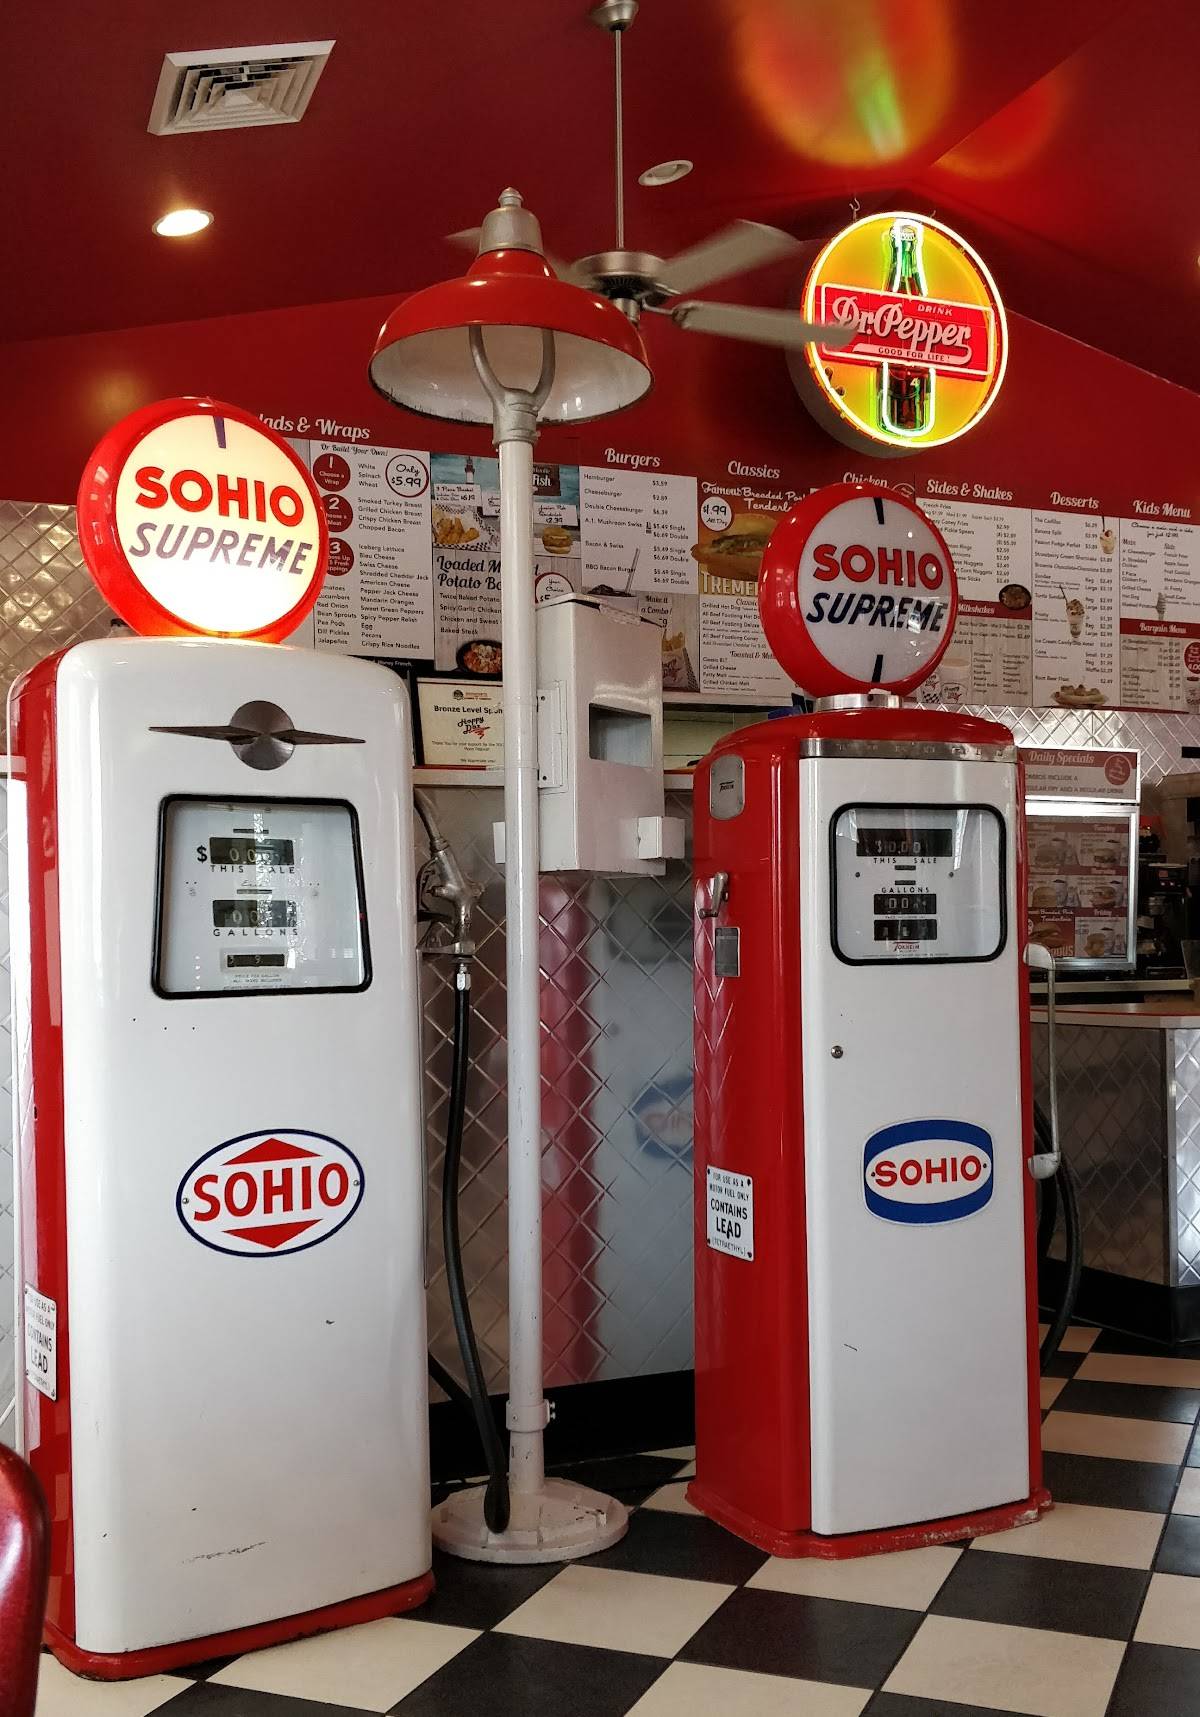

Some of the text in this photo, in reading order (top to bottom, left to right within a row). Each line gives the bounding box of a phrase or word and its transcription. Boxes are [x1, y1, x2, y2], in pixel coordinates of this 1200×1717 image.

[918, 304, 953, 316] DRINK
[878, 347, 902, 356] GOOD
[906, 350, 924, 358] FOR
[316, 419, 370, 442] Wraps
[604, 448, 660, 469] Burgers
[396, 464, 420, 476] Only
[728, 460, 780, 480] Classics
[392, 477, 421, 488] $5.99
[584, 474, 615, 482] Hamburger
[135, 466, 304, 527] SOHIO
[584, 489, 622, 497] Cheeseburger
[926, 480, 1013, 501] Sides & Shakes
[329, 498, 339, 510] 2
[1050, 491, 1099, 509] Desserts
[605, 505, 643, 514] Cheeseburger
[703, 504, 727, 516] $1.99
[1133, 500, 1191, 518] Kids Menu
[358, 515, 377, 523] Crispy
[598, 519, 626, 527] Mushroom
[359, 524, 386, 532] Chopped
[128, 522, 313, 575] SUPREME
[330, 542, 341, 553] 3
[359, 544, 381, 552] Iceberg
[437, 556, 484, 573] Loaded
[813, 544, 943, 590] SOHIO
[438, 573, 482, 588] Potato
[806, 592, 948, 632] SUPREME
[1140, 623, 1168, 634] Bargain
[1028, 751, 1095, 766] Daily Specials
[196, 845, 208, 863] $
[258, 866, 295, 874] SALE
[875, 1155, 982, 1187] SOHIO
[723, 1176, 731, 1184] USE
[733, 1178, 738, 1186] AS
[194, 1162, 349, 1222] SOHIO
[725, 1187, 735, 1198] FUEL
[737, 1192, 749, 1201] ONLY
[711, 1198, 748, 1220] CONTAINS
[716, 1216, 741, 1238] LEAD
